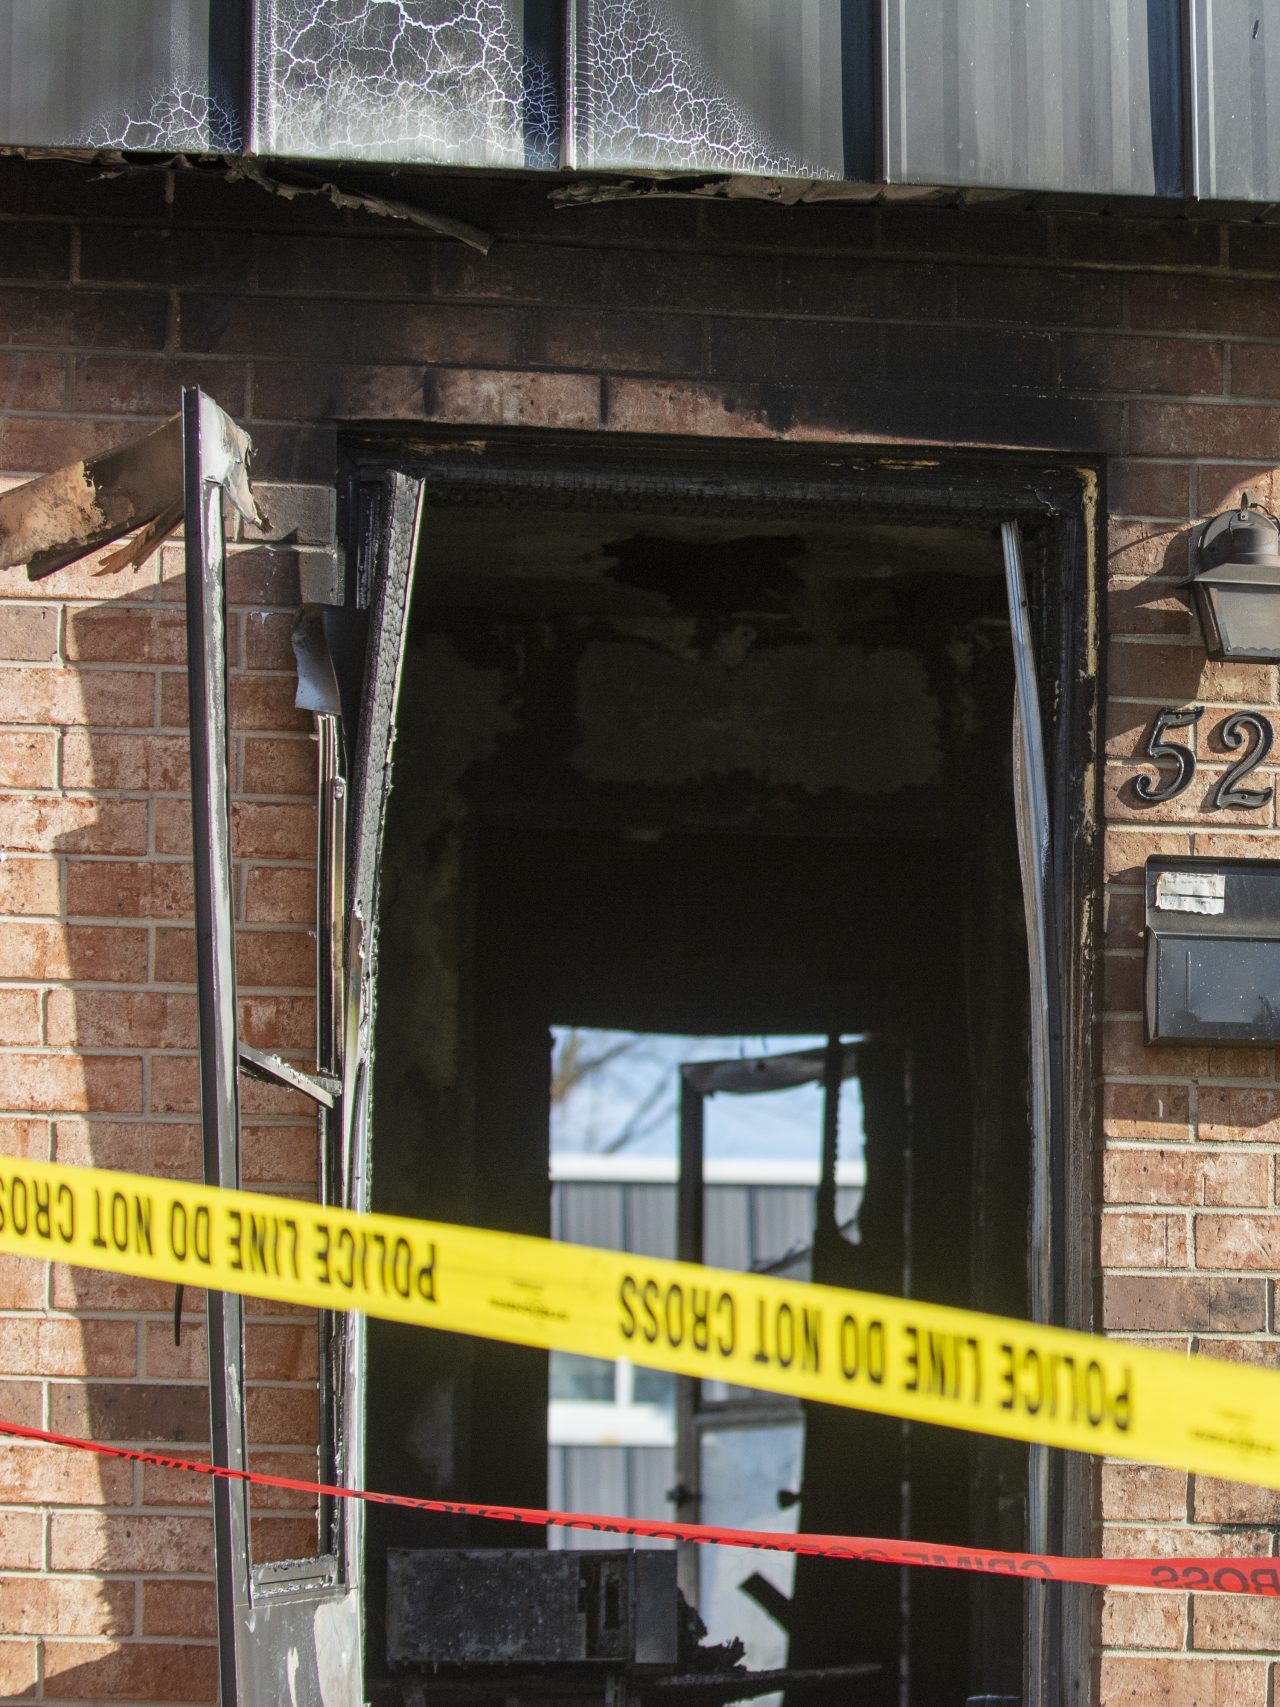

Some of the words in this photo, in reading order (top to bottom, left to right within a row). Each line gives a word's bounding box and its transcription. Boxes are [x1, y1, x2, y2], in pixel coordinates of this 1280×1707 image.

[91, 1187, 154, 1257] NOT
[169, 1199, 213, 1266] DO
[227, 1209, 300, 1281] LINE
[313, 1224, 440, 1304] POLICE
[619, 1274, 736, 1358] CROSS
[751, 1299, 822, 1374] NOT
[839, 1313, 885, 1386] DO
[904, 1325, 982, 1407] LINE
[999, 1343, 1134, 1434] POLICE
